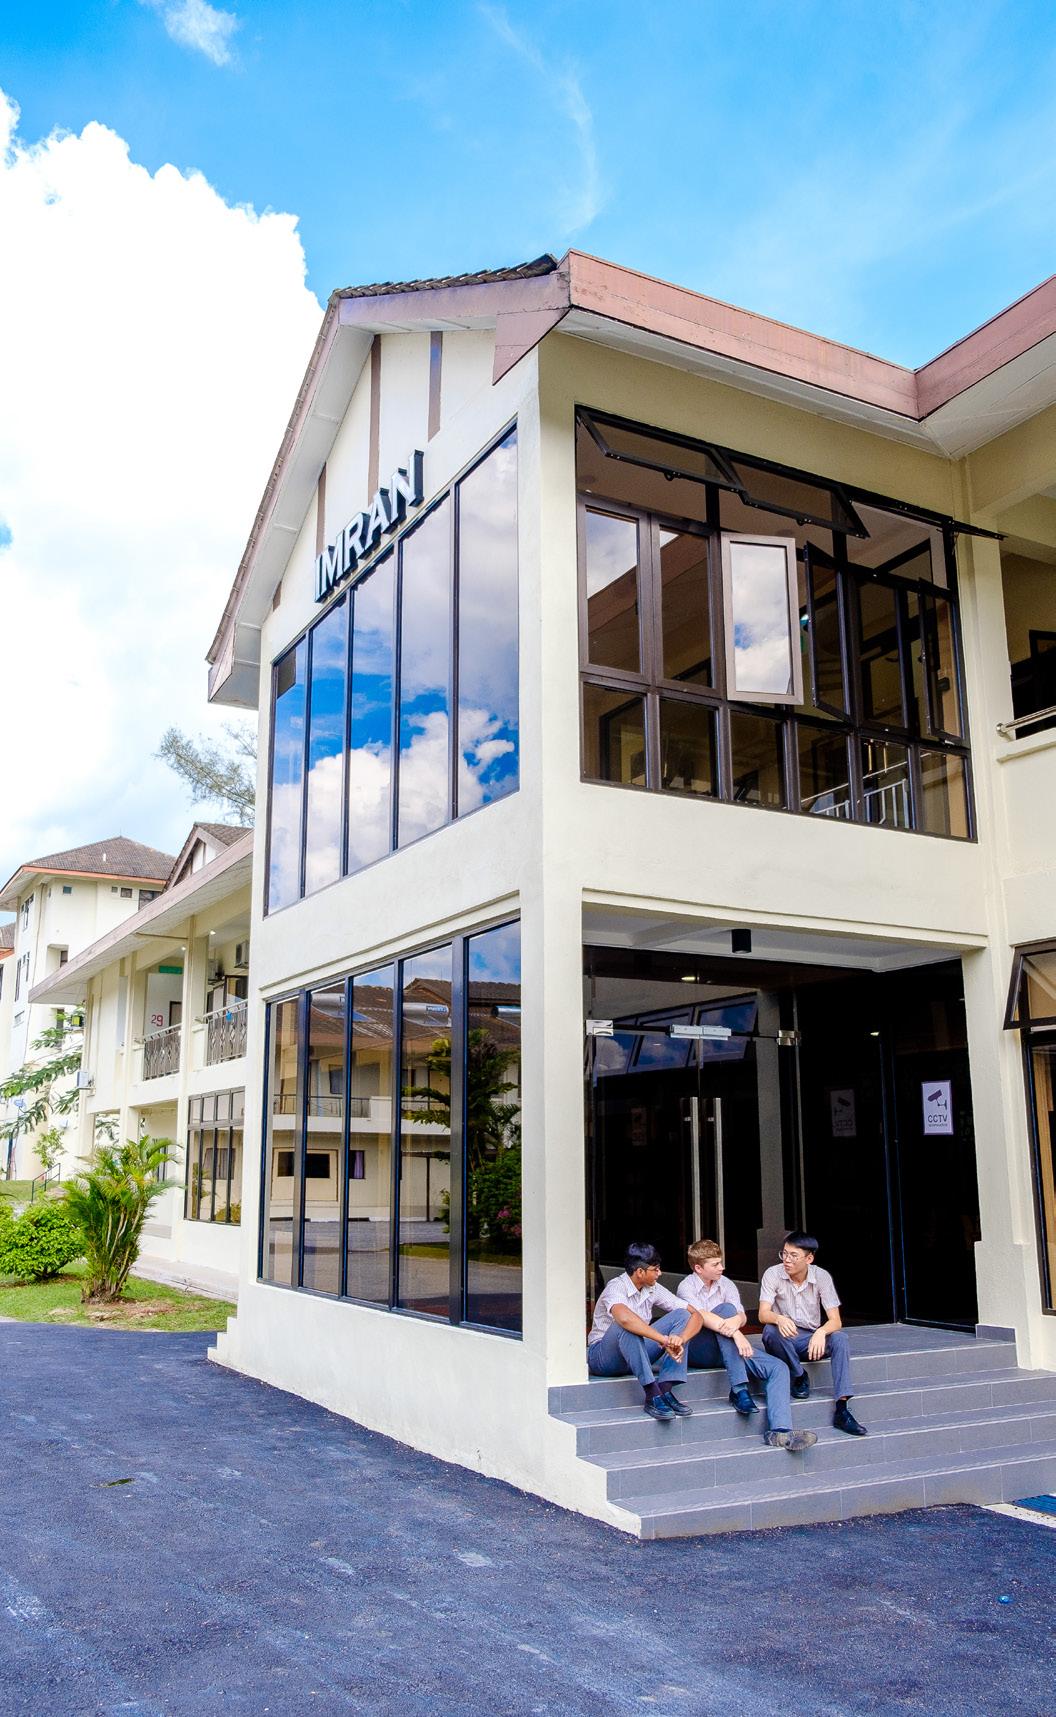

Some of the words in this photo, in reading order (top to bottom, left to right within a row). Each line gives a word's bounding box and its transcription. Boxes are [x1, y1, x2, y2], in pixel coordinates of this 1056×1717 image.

[315, 449, 424, 603] IMRAN
[151, 1014, 164, 1027] 29
[927, 1114, 948, 1123] CCTV
